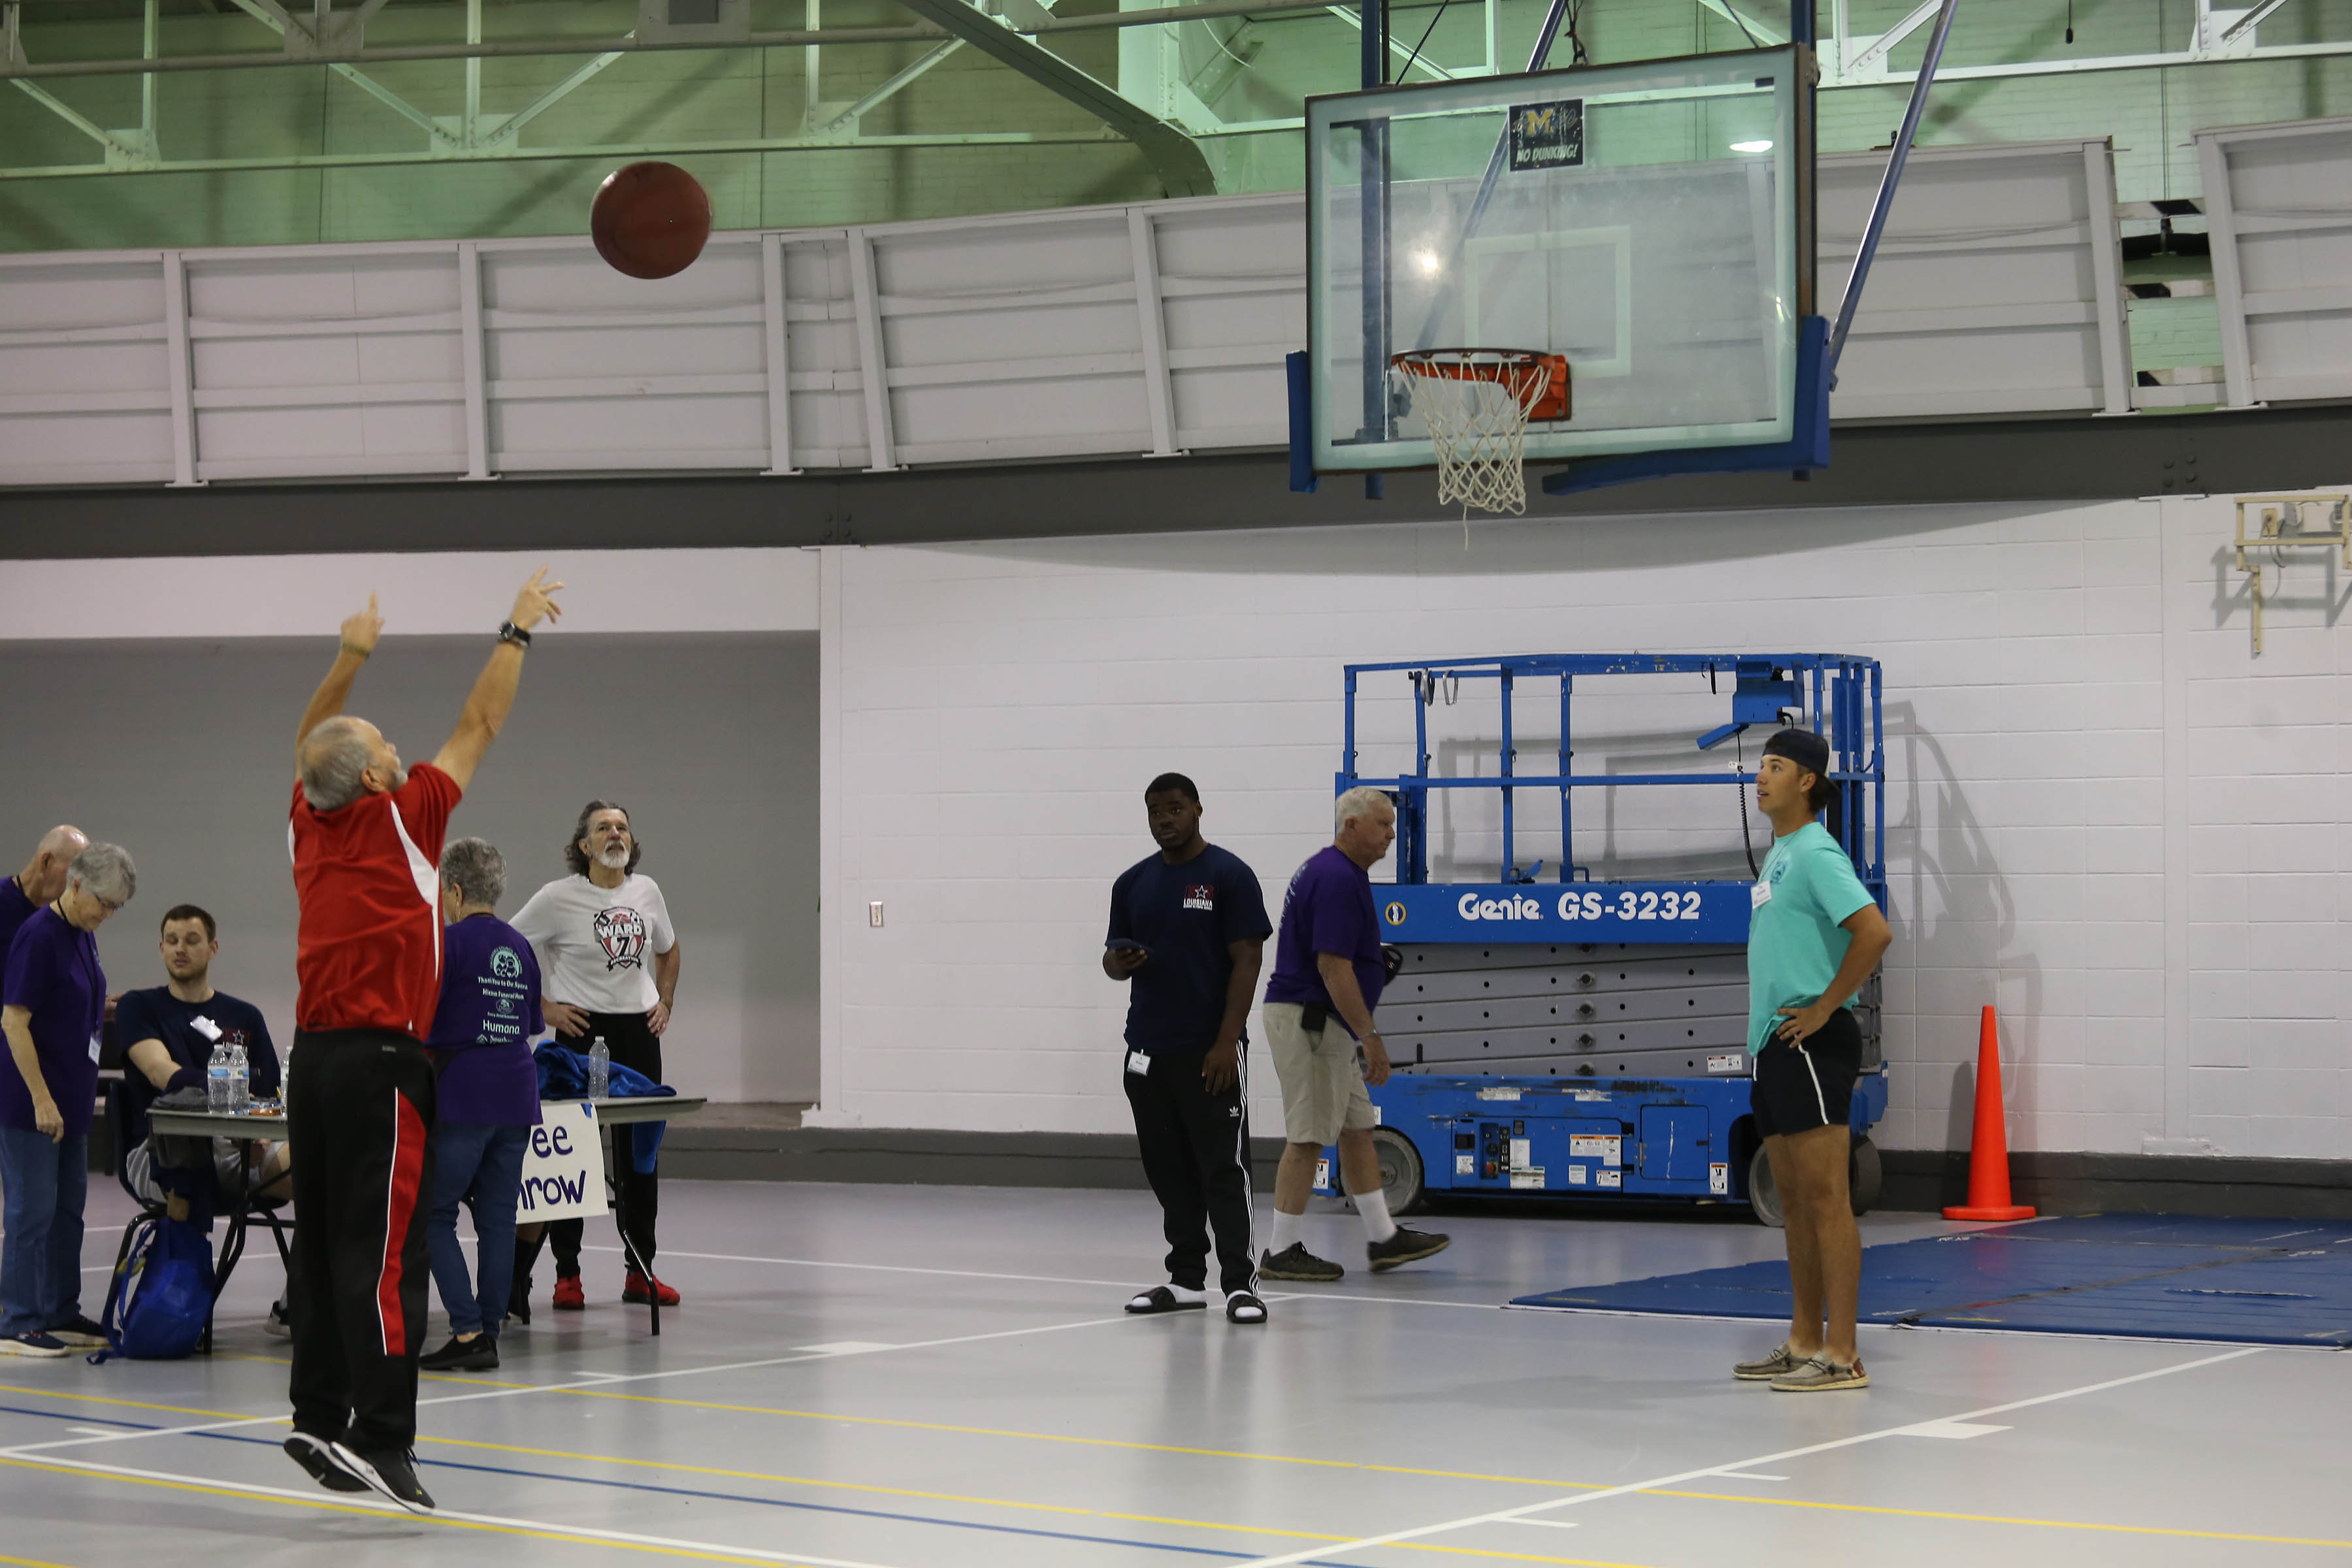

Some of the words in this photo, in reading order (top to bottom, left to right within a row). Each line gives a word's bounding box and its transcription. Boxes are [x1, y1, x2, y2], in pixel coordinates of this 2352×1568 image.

[1516, 148, 1531, 163] NO
[1532, 144, 1578, 161] DUNKING!
[1183, 898, 1213, 909] LOUISIANA
[1458, 892, 1541, 920] Genie
[1558, 891, 1701, 920] GS-3232
[597, 923, 643, 939] WARD
[616, 936, 630, 956] 7
[532, 1126, 573, 1158] ee
[520, 1169, 586, 1211] row
